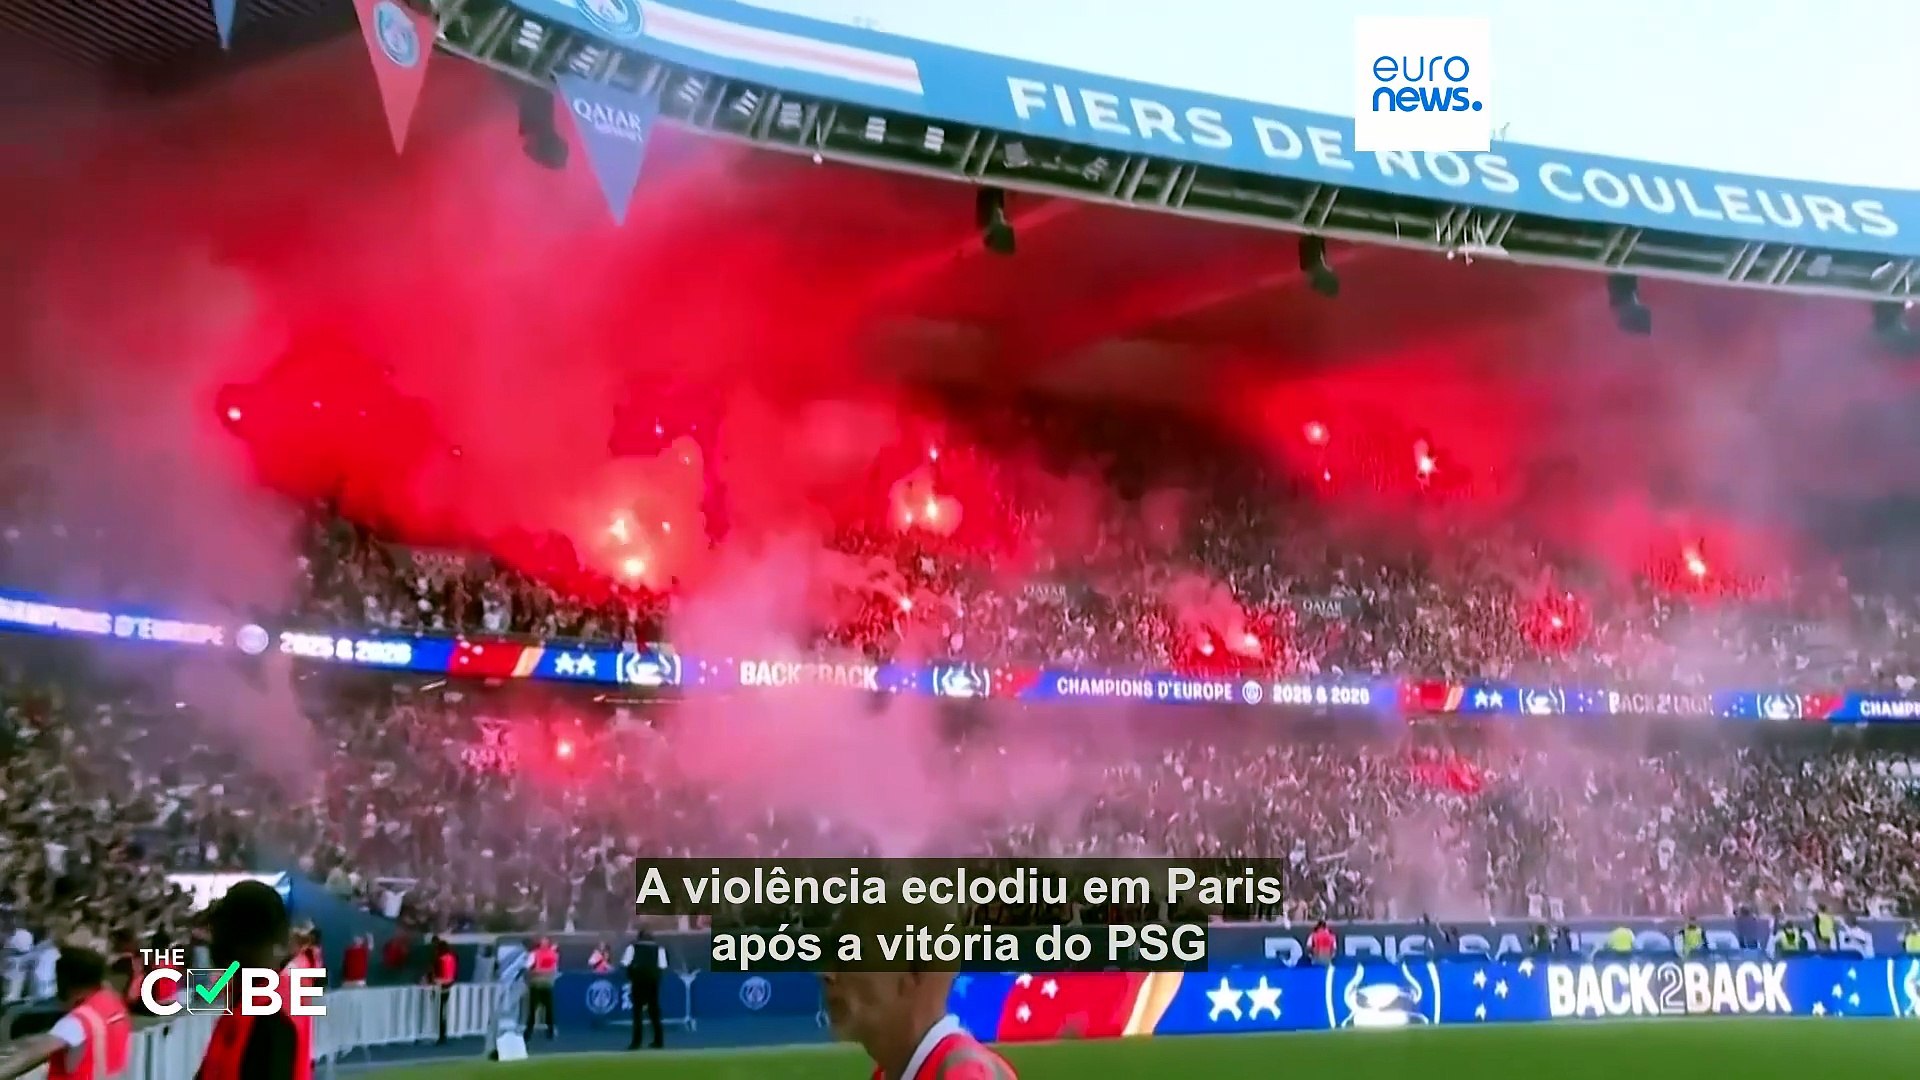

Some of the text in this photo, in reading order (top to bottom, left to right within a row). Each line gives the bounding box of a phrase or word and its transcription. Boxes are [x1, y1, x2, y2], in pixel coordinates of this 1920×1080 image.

[572, 98, 642, 132] QATAR
[1006, 76, 1900, 238] FIERS DE NOS COULEURS
[740, 661, 878, 691] BACKBACK
[1056, 676, 1233, 701] CHAMPIONS D'EUROPE
[1264, 933, 1435, 967] PRIS
[1547, 961, 1793, 1018] BACK2BACK
